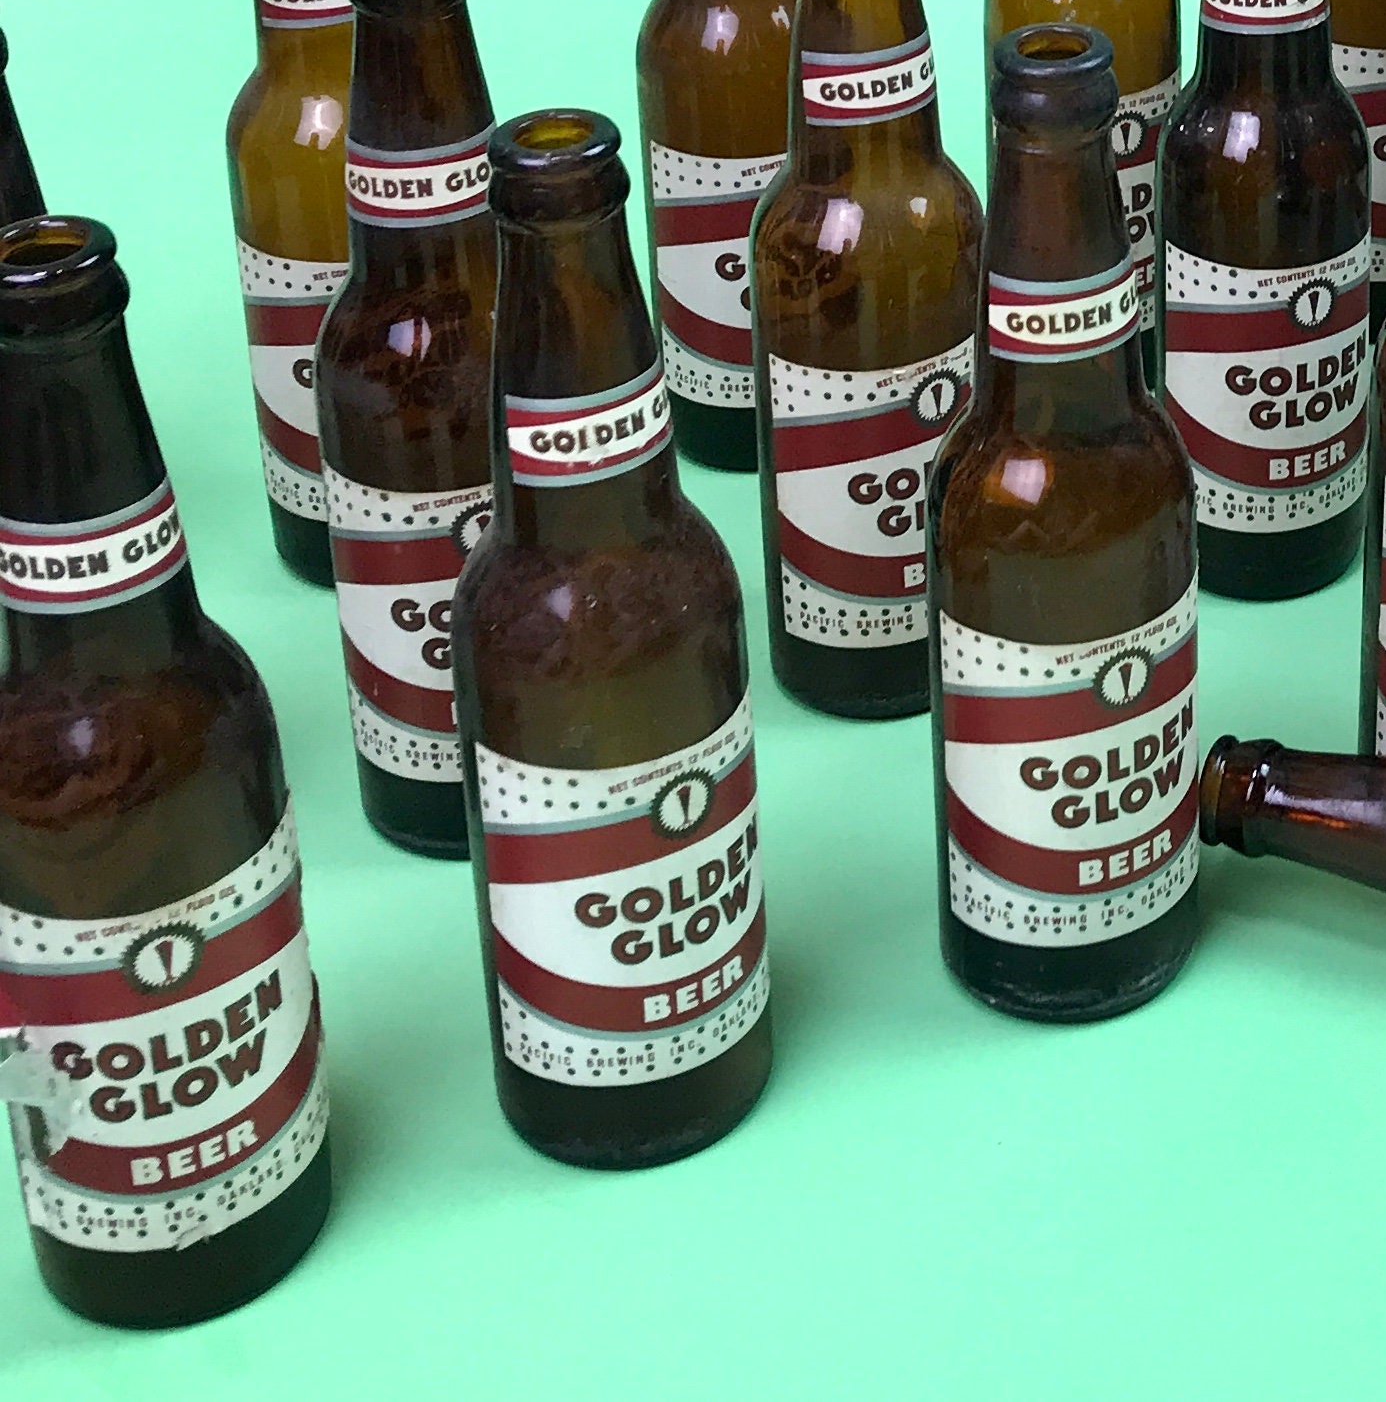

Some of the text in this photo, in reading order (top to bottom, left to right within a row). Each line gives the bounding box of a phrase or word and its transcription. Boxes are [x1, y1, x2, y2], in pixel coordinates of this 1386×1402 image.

[820, 70, 913, 102] GOLDEN
[348, 162, 490, 198] GOLDEN GLO
[1006, 301, 1111, 334] GOLDEN
[720, 383, 754, 393] BREWI
[1225, 328, 1367, 396] GOLDEN
[1249, 372, 1359, 431] GLOW
[1269, 440, 1346, 481] BEER
[1223, 501, 1275, 514] BREWING
[857, 613, 913, 629] BREWING
[1019, 693, 1194, 792] GOLDEN
[1051, 748, 1185, 829] GLOW
[574, 813, 758, 928] GOLDEN
[1079, 828, 1173, 887] BEER
[610, 871, 751, 966] GLOW
[1024, 914, 1088, 926] BREWING
[643, 954, 744, 1024] BEER
[51, 968, 283, 1080] GOLDEN
[90, 1027, 268, 1124] GLOW
[586, 1052, 656, 1069] BREWING
[130, 1119, 261, 1187] BEER
